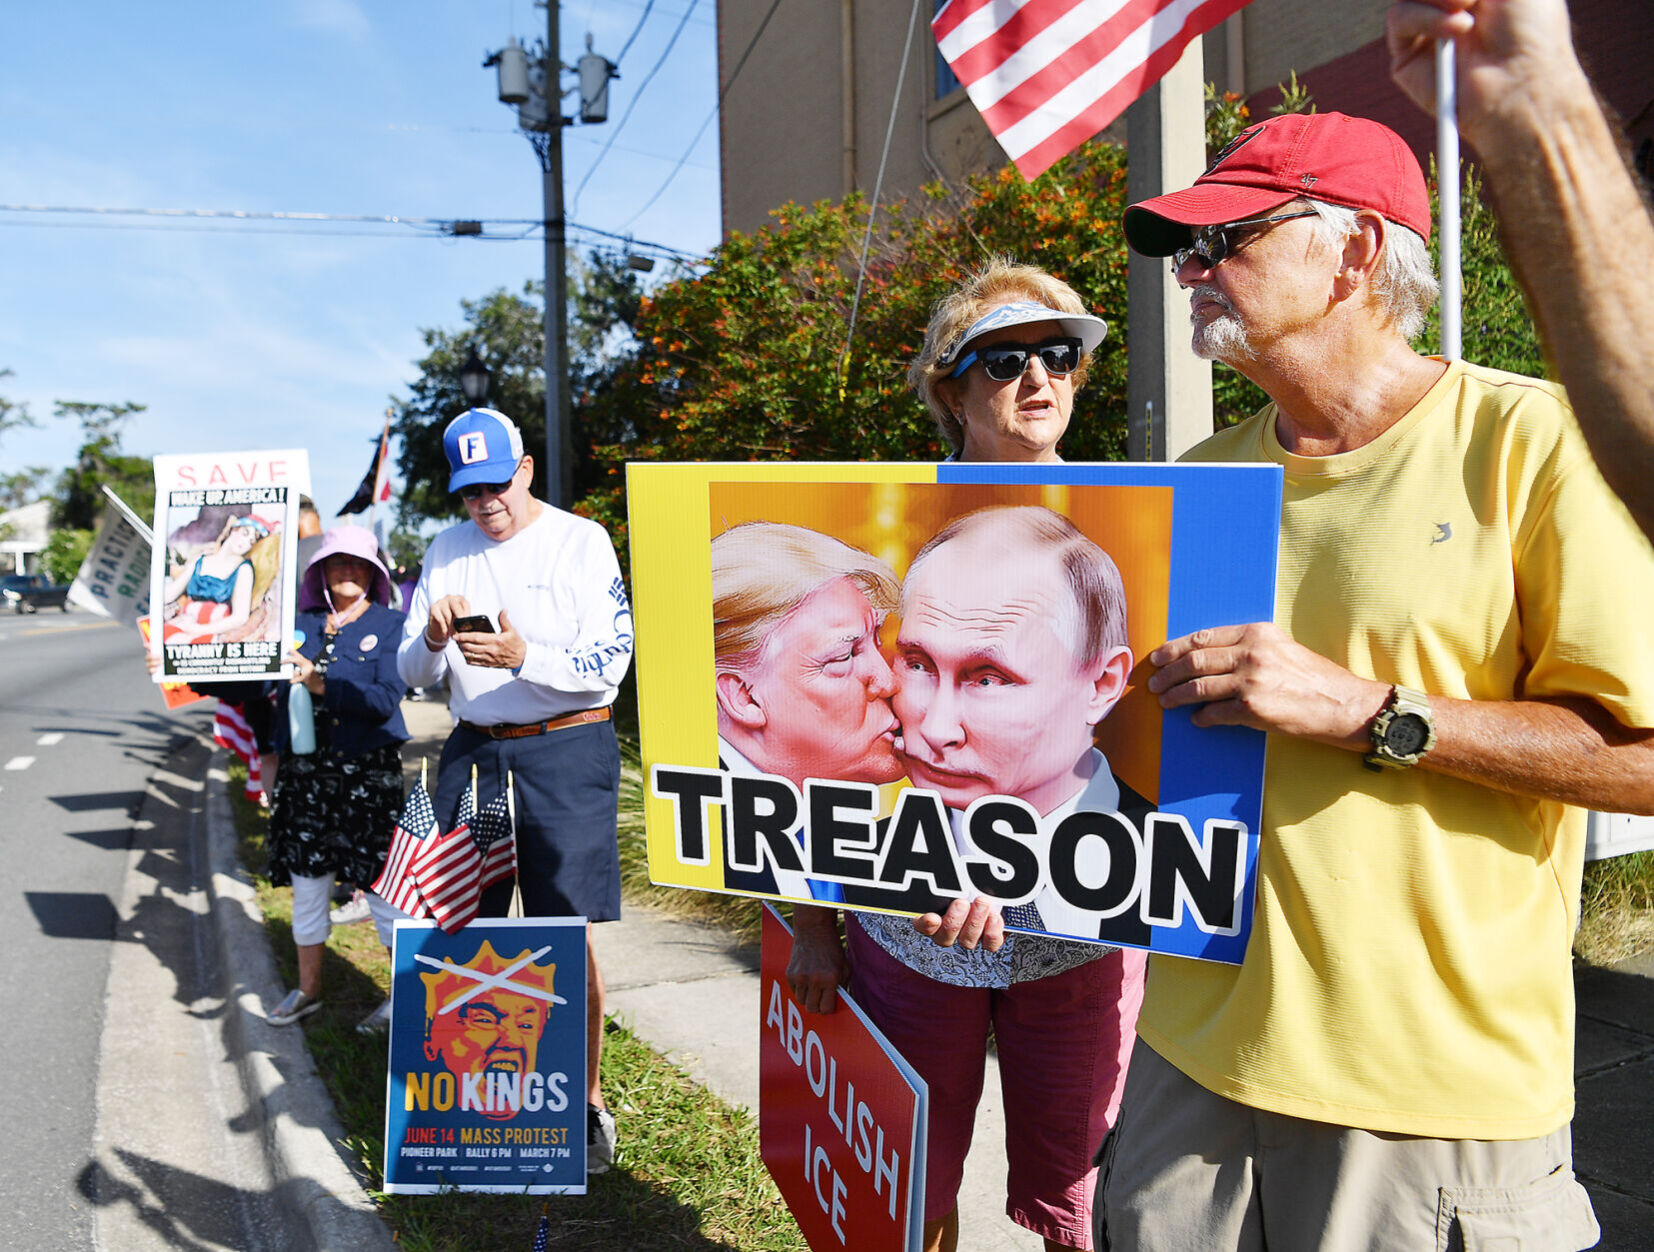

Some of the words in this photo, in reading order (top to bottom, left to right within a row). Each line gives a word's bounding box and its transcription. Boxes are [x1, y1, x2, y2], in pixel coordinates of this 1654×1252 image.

[467, 437, 479, 459] F
[227, 643, 241, 657] IS
[653, 767, 1244, 931] TREASON
[404, 1072, 455, 1111] NO
[461, 1072, 569, 1112] KINGS
[766, 980, 899, 1221] ABOLISH
[404, 1128, 437, 1144] JUNE
[441, 1128, 454, 1144] 14
[460, 1128, 500, 1144] MASS
[505, 1128, 569, 1144] PROTEST
[400, 1147, 435, 1157] PIONEER
[436, 1147, 458, 1157] PARK
[465, 1147, 490, 1158] RALLY
[491, 1147, 497, 1157] 6
[499, 1147, 512, 1157] PM
[520, 1147, 550, 1157] MARCH
[550, 1147, 556, 1157] 7
[557, 1147, 570, 1158] PM
[804, 1123, 848, 1246] ICE
